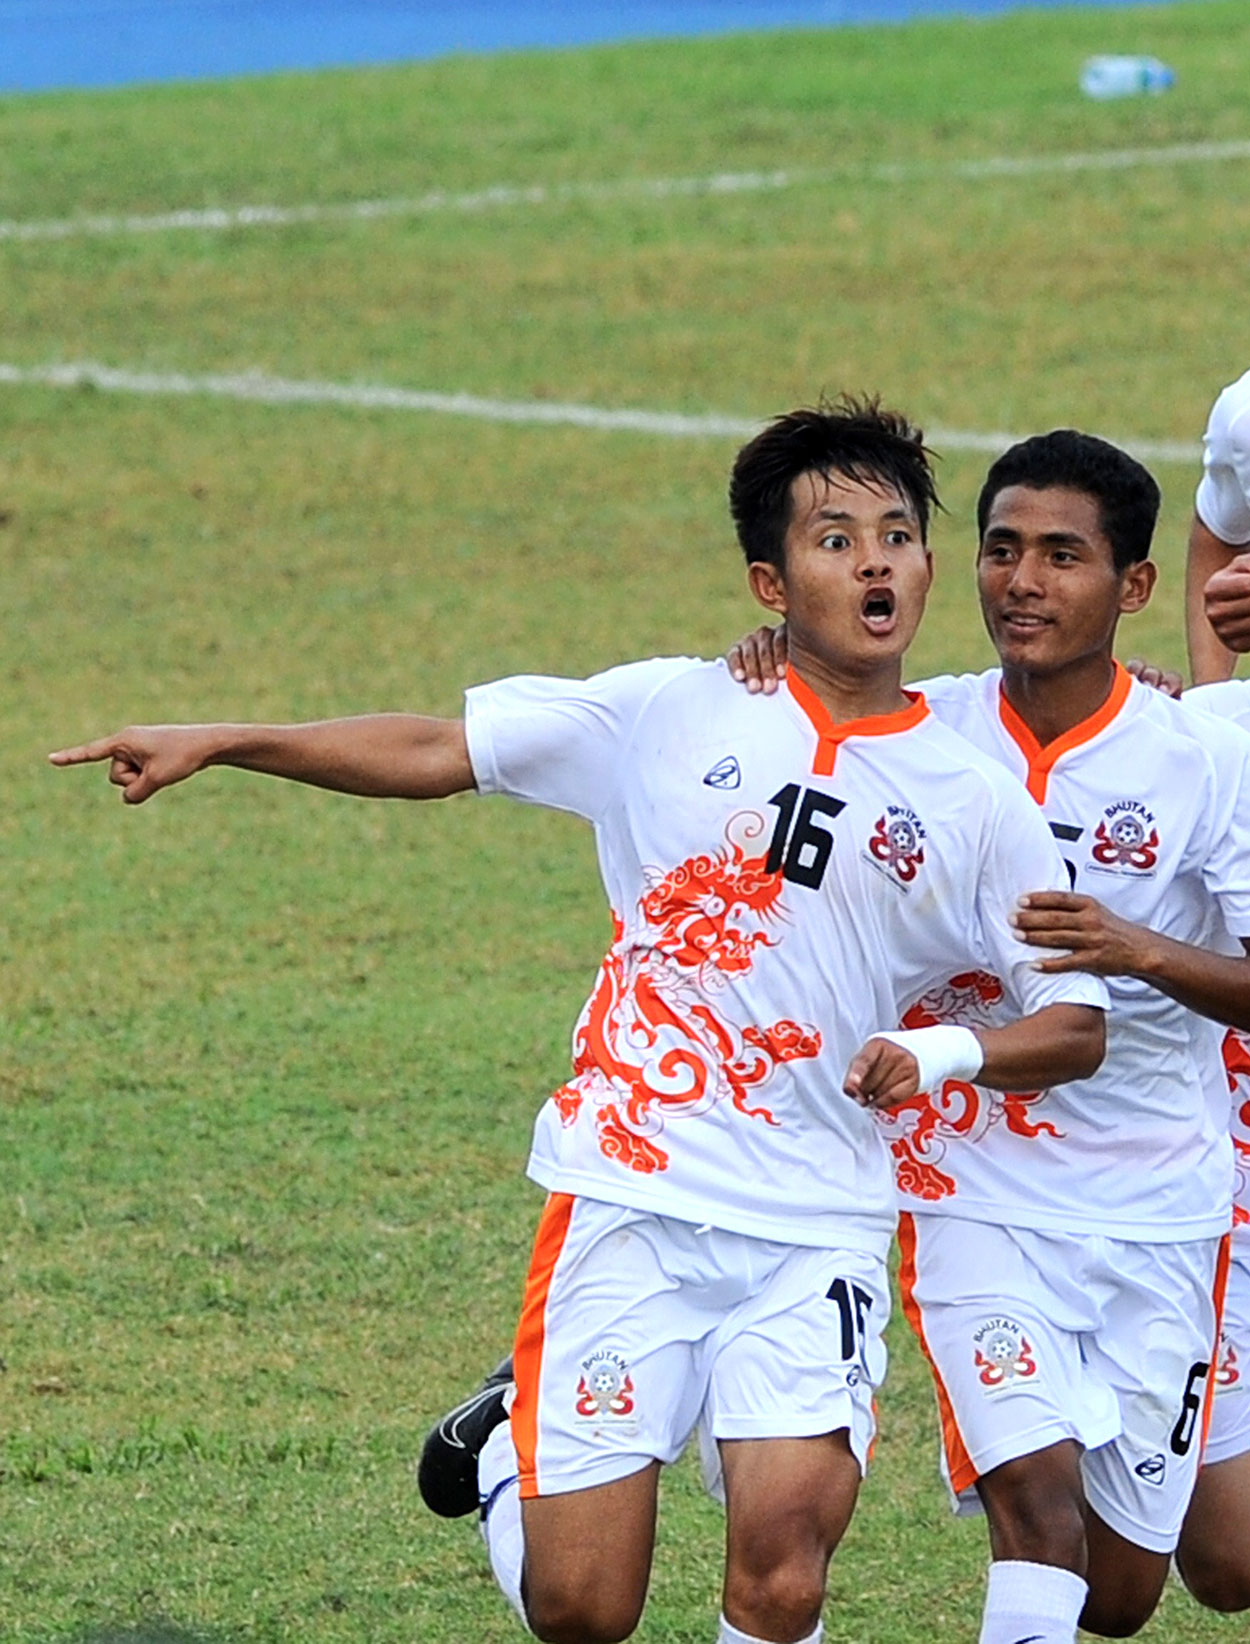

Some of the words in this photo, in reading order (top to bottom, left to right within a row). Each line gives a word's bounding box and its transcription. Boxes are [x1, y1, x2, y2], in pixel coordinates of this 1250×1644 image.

[1104, 799, 1156, 824] BHUTAN
[765, 782, 847, 891] 16
[973, 1319, 1020, 1343] BHUTAN
[581, 1350, 629, 1371] BHUTAN
[1171, 1361, 1210, 1456] 6
